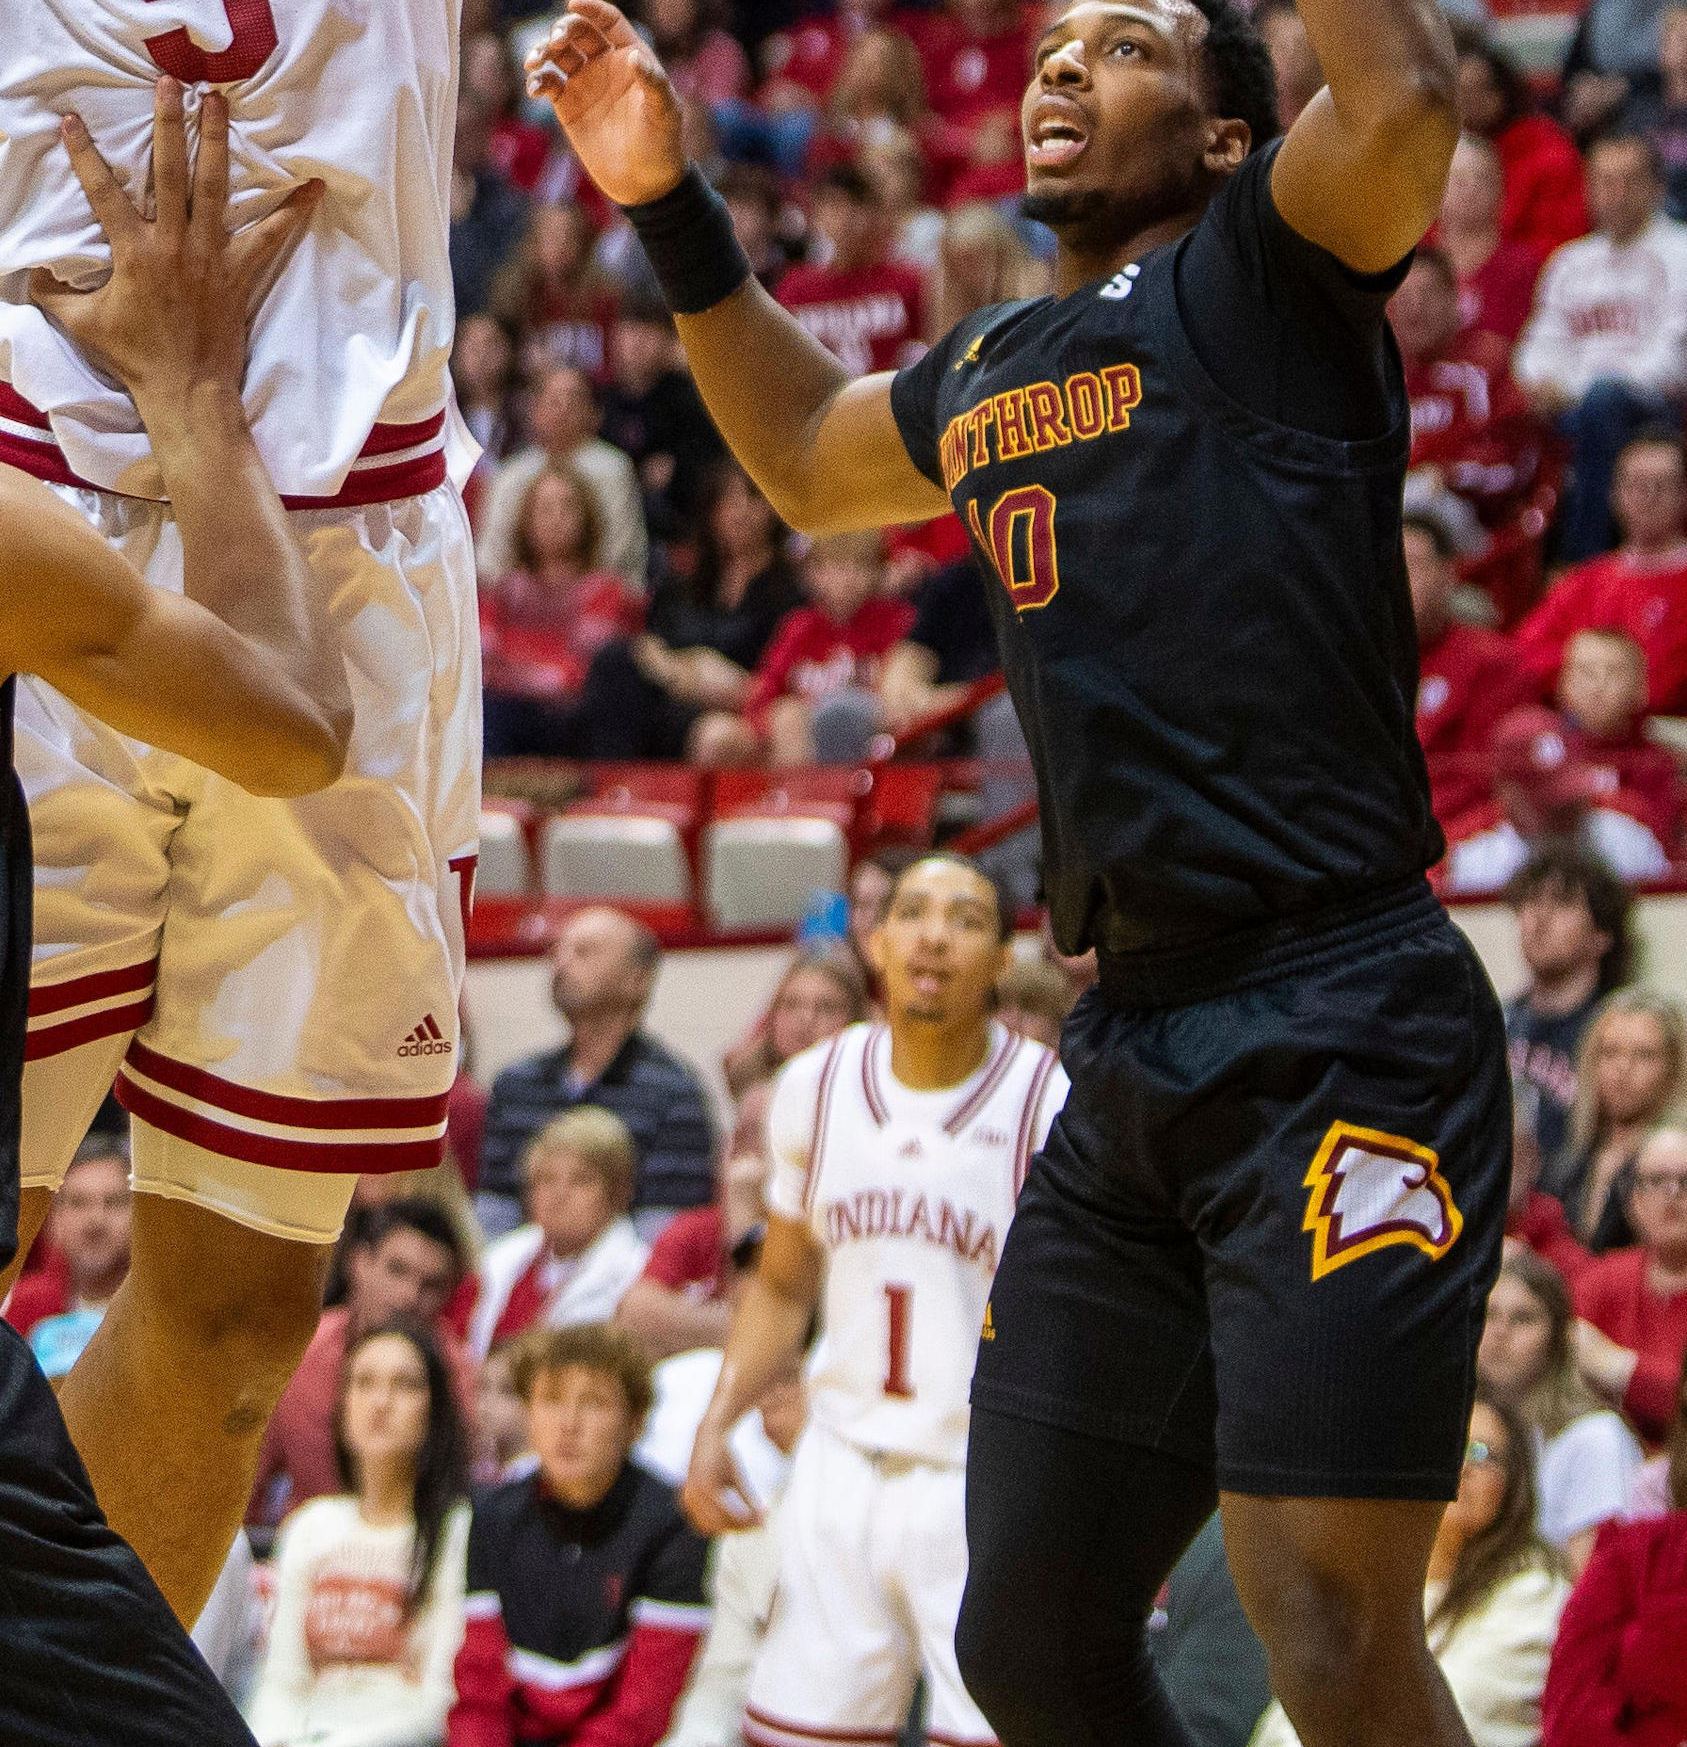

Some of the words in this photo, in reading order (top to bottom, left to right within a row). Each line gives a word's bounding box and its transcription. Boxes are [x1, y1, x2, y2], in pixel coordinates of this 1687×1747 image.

[938, 362, 1143, 497] INTHROP
[397, 1040, 453, 1058] adidas
[883, 1280, 916, 1399] 1
